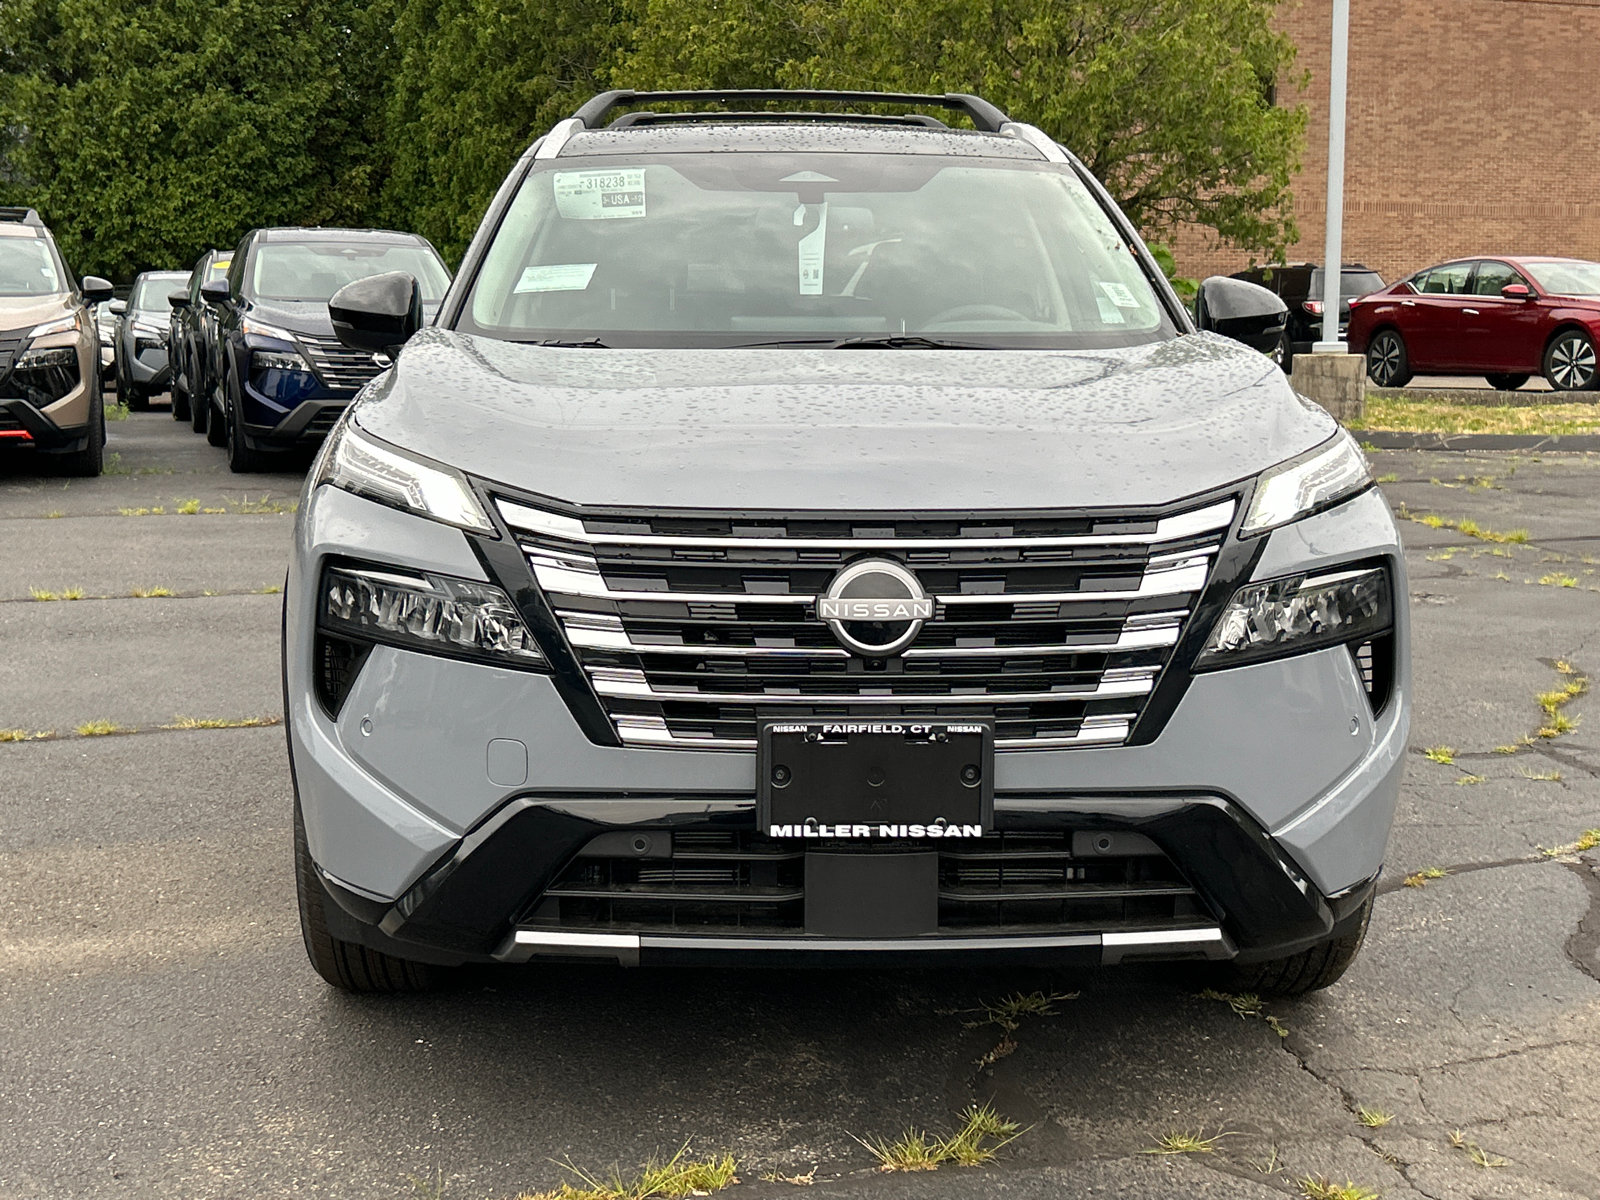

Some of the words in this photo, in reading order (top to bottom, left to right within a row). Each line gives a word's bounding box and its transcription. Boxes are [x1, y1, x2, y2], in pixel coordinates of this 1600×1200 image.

[586, 176, 625, 189] 318238
[611, 194, 630, 205] USA
[822, 603, 929, 617] NISSAN
[773, 725, 807, 733] NISSAN
[823, 724, 906, 734] FAIRFIELD,
[910, 724, 932, 733] CT
[947, 725, 982, 733] NISSAN
[770, 824, 870, 838] MILLER
[879, 824, 982, 838] NISSAN
